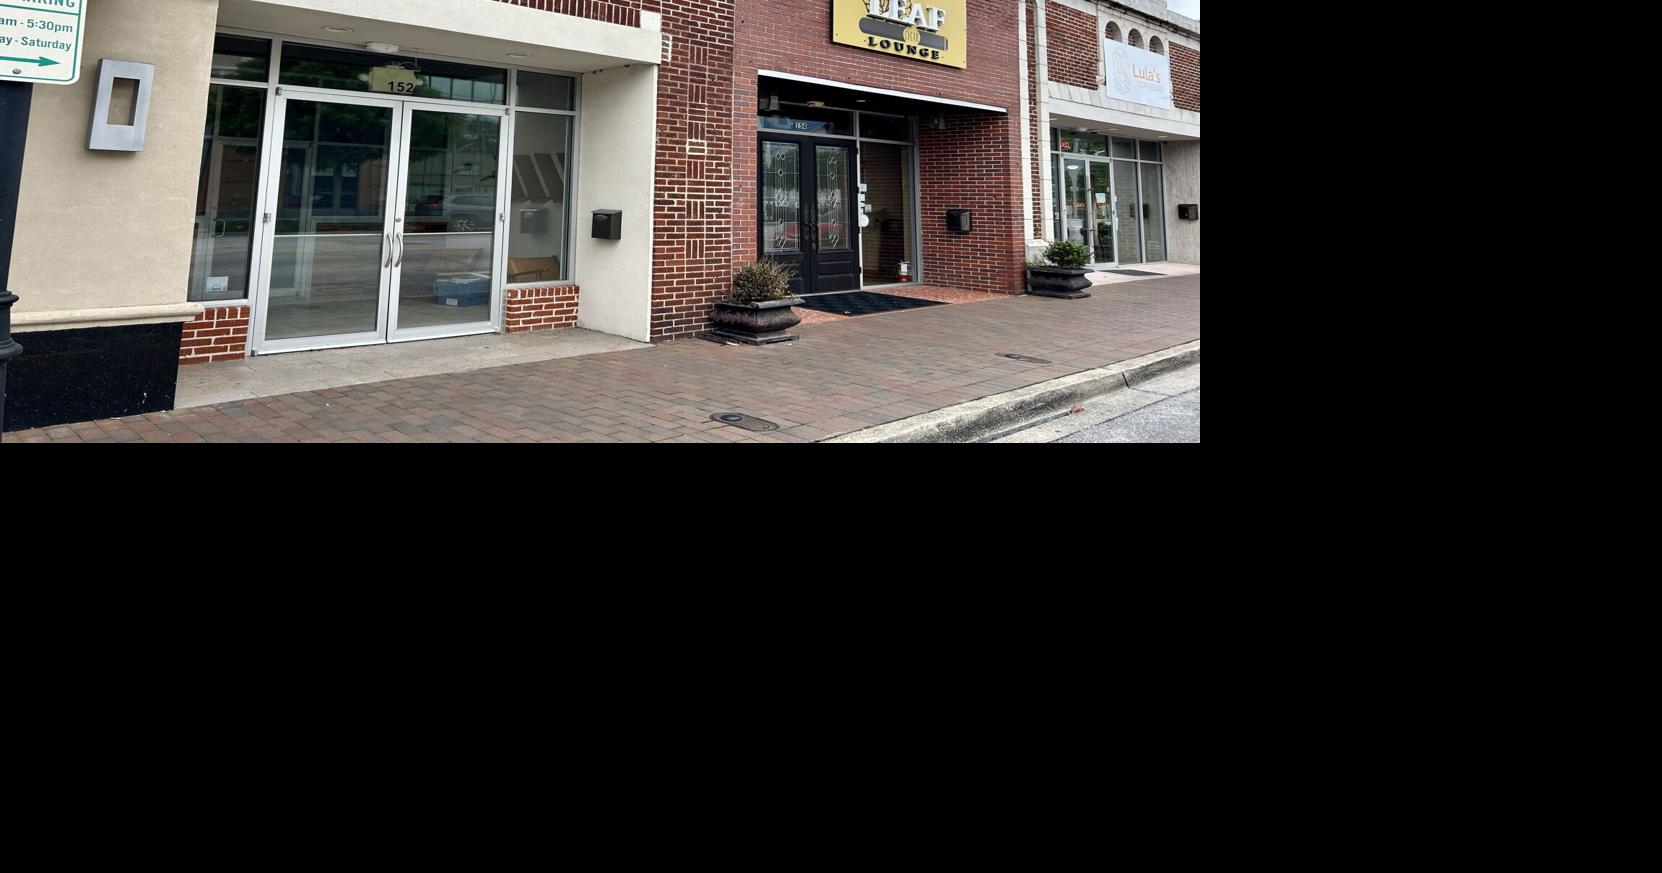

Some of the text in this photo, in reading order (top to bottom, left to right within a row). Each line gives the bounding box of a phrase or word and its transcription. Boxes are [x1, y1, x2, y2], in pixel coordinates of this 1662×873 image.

[867, 0, 945, 31] LEAF
[27, 18, 73, 33] 5:30pm
[21, 36, 72, 52] Saturday
[867, 36, 940, 60] LOUNGE
[1132, 63, 1161, 84] Lula's
[388, 80, 414, 93] 152
